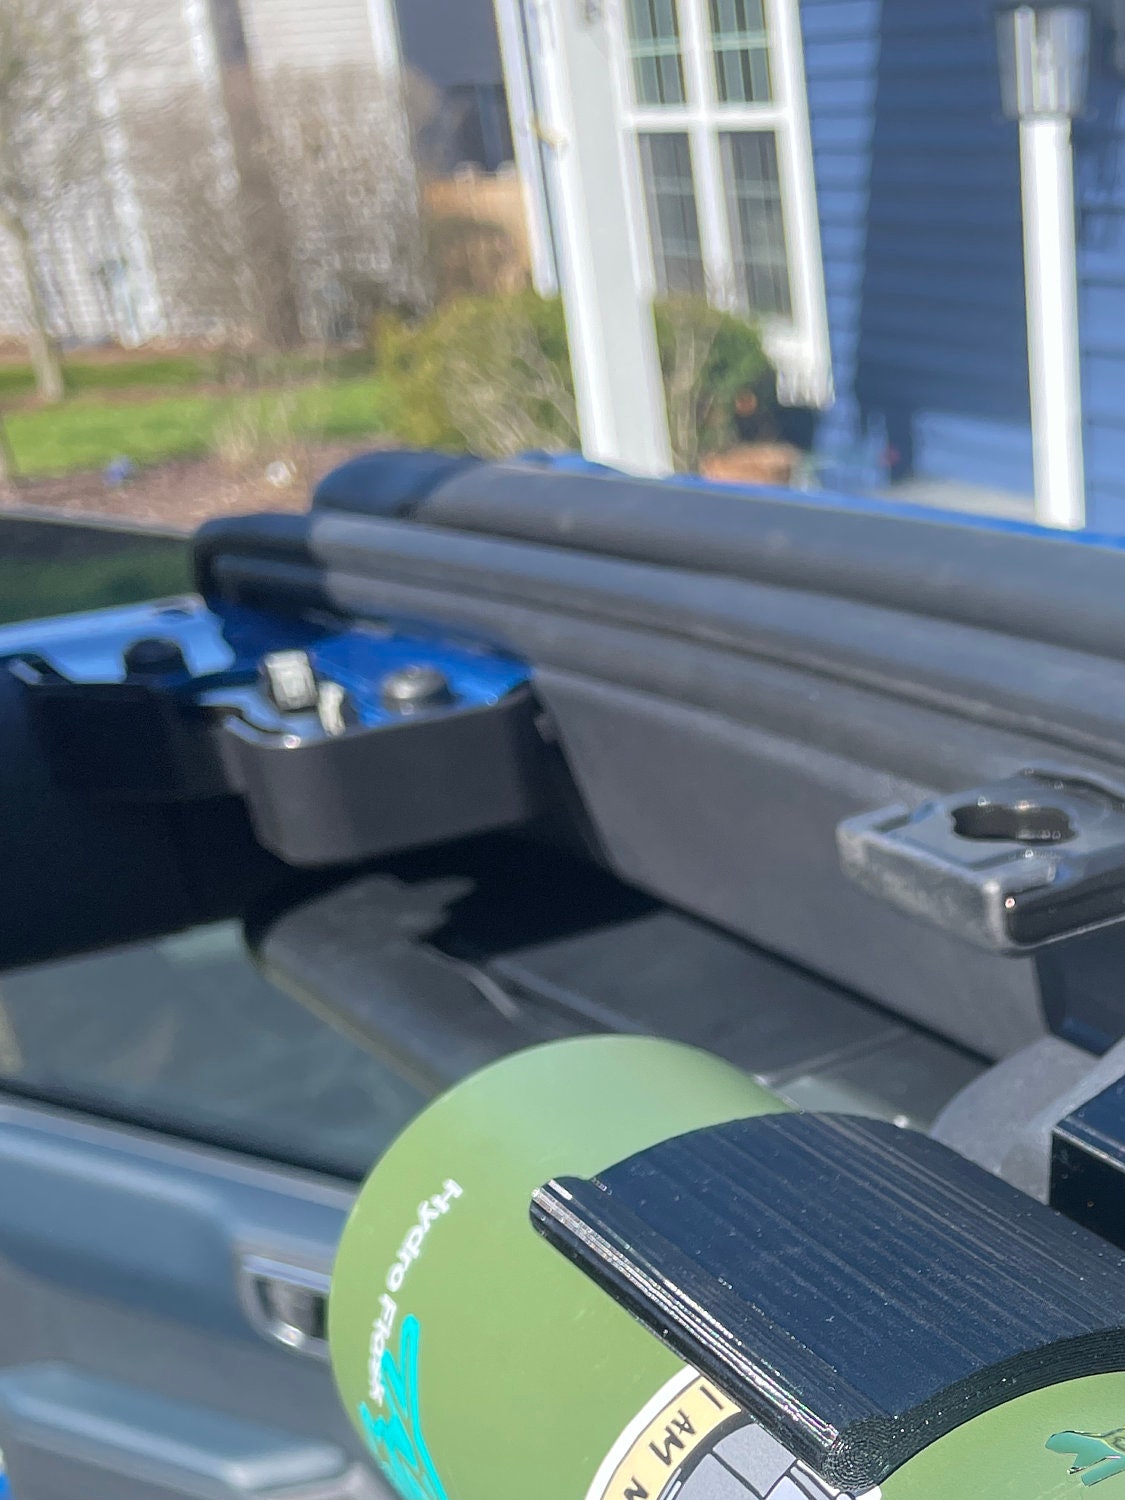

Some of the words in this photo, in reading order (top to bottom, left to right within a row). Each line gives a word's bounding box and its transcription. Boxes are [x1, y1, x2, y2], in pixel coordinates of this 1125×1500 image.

[387, 1178, 463, 1292] Hydro
[699, 1385, 724, 1410] I
[649, 1408, 696, 1466] AM
